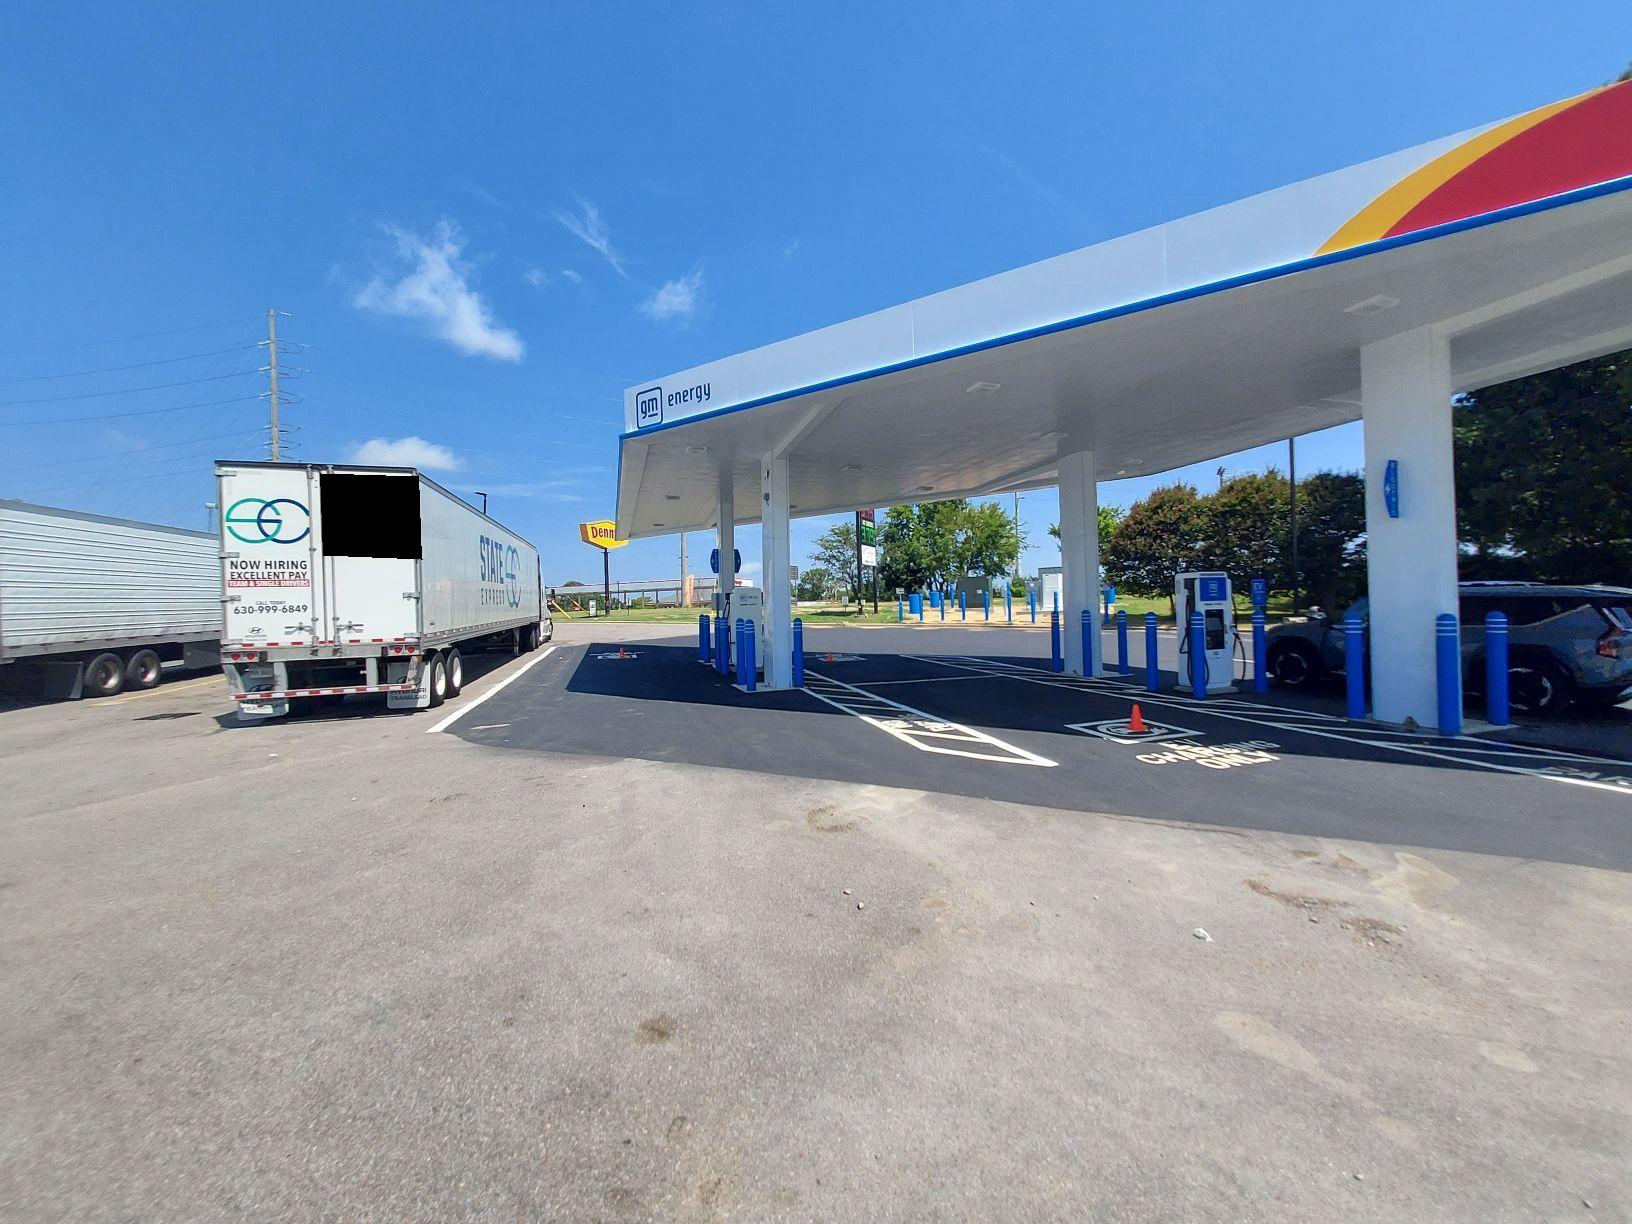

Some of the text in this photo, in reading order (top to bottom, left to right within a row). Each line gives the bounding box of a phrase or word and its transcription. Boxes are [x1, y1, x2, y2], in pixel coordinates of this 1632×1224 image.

[640, 383, 712, 419] gm energy
[591, 526, 615, 539] Denn
[230, 560, 308, 570] NOW HIRING
[480, 534, 504, 584] STATE
[230, 571, 308, 580] EXCELLENT PAY
[233, 604, 308, 615] 630-999-6849
[1196, 750, 1281, 770] ONLY
